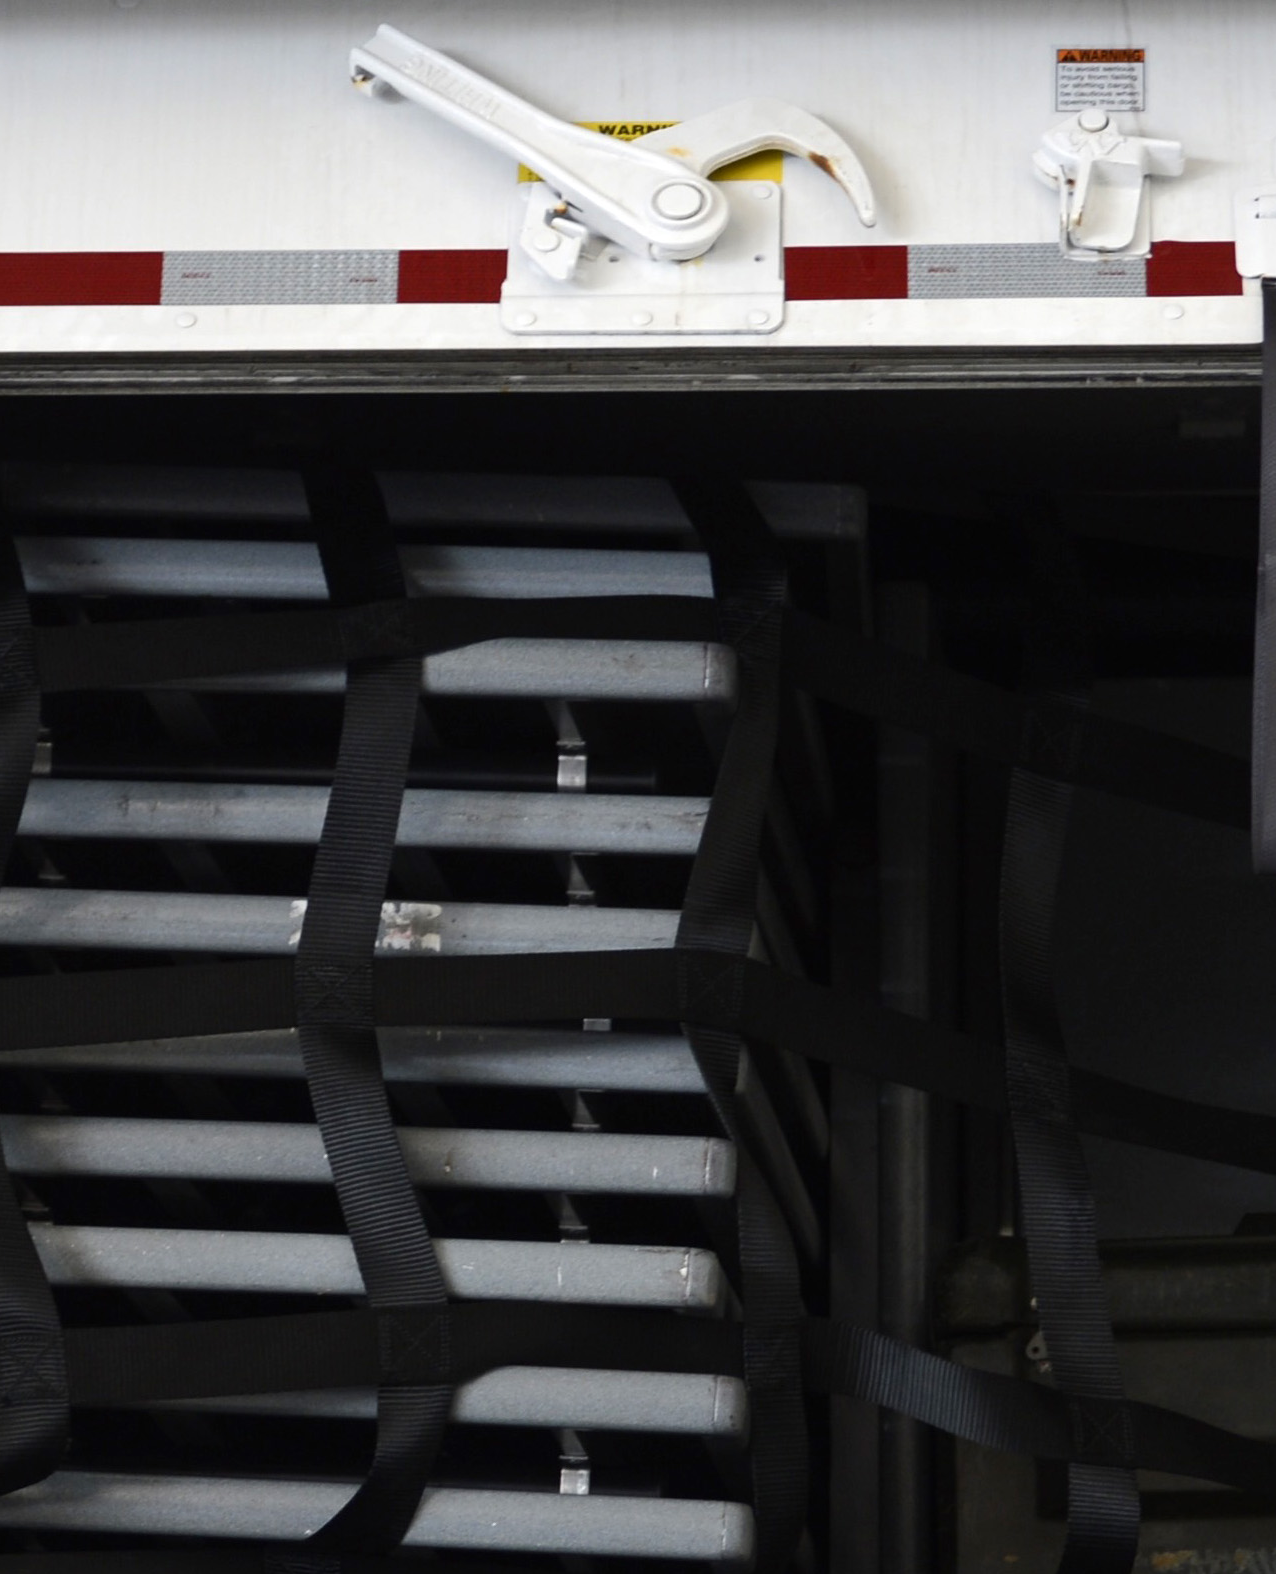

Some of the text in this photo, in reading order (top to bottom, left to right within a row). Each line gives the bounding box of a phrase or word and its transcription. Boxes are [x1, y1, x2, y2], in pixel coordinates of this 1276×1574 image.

[1079, 50, 1141, 62] WARNING
[1110, 74, 1138, 82] falling
[1072, 82, 1105, 90] shifting
[599, 124, 673, 135] WARN
